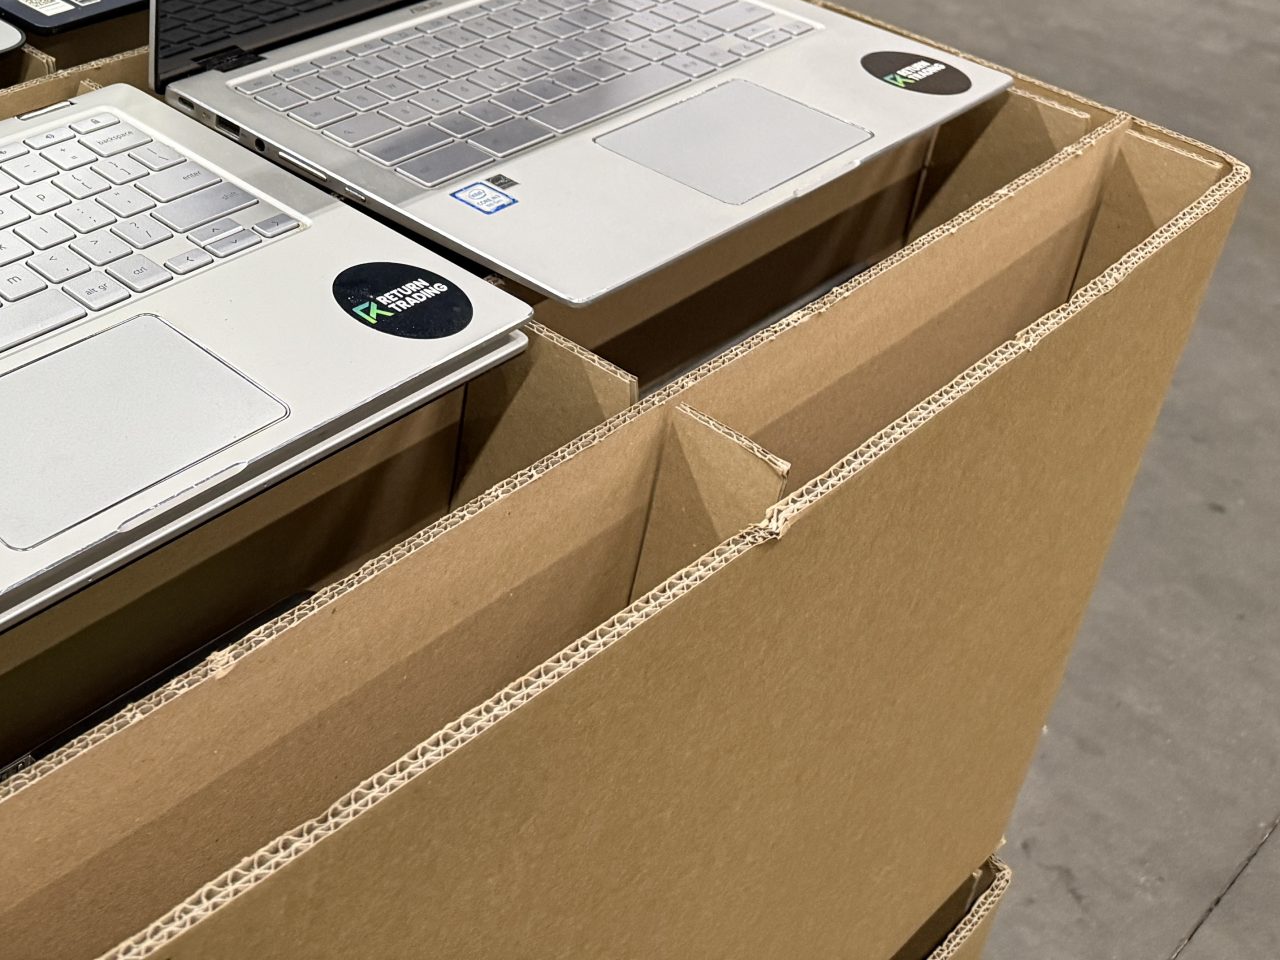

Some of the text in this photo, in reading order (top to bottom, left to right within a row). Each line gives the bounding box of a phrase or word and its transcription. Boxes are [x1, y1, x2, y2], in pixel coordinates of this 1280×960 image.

[36, 193, 46, 202] p
[7, 275, 22, 284] m
[376, 278, 430, 306] RETURN
[387, 282, 448, 313] TRADING
